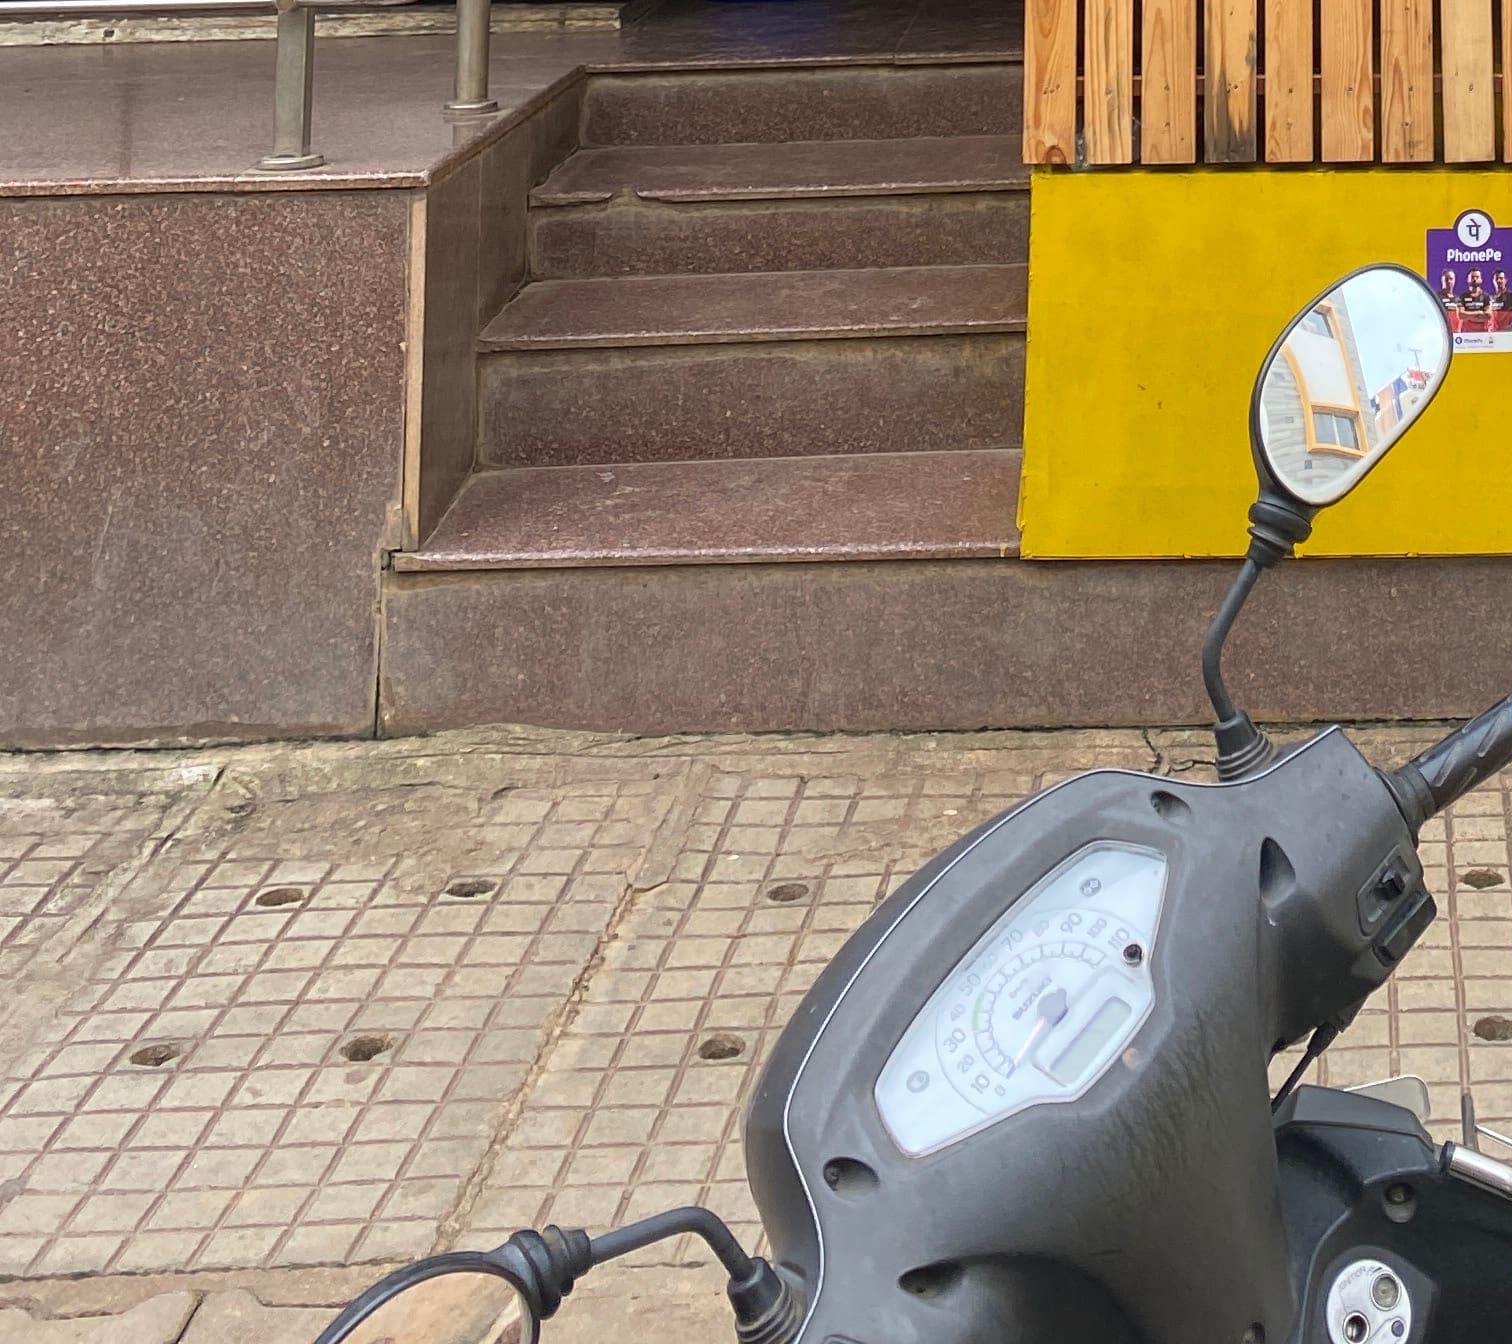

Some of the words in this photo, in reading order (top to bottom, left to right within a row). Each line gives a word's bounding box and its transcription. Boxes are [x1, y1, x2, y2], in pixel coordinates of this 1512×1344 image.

[1466, 218, 1482, 241] पे
[1446, 248, 1502, 262] PhonePe
[1059, 912, 1083, 934] 90
[1000, 928, 1024, 952] 70
[944, 1027, 966, 1053] 30
[970, 1074, 990, 1094] 10
